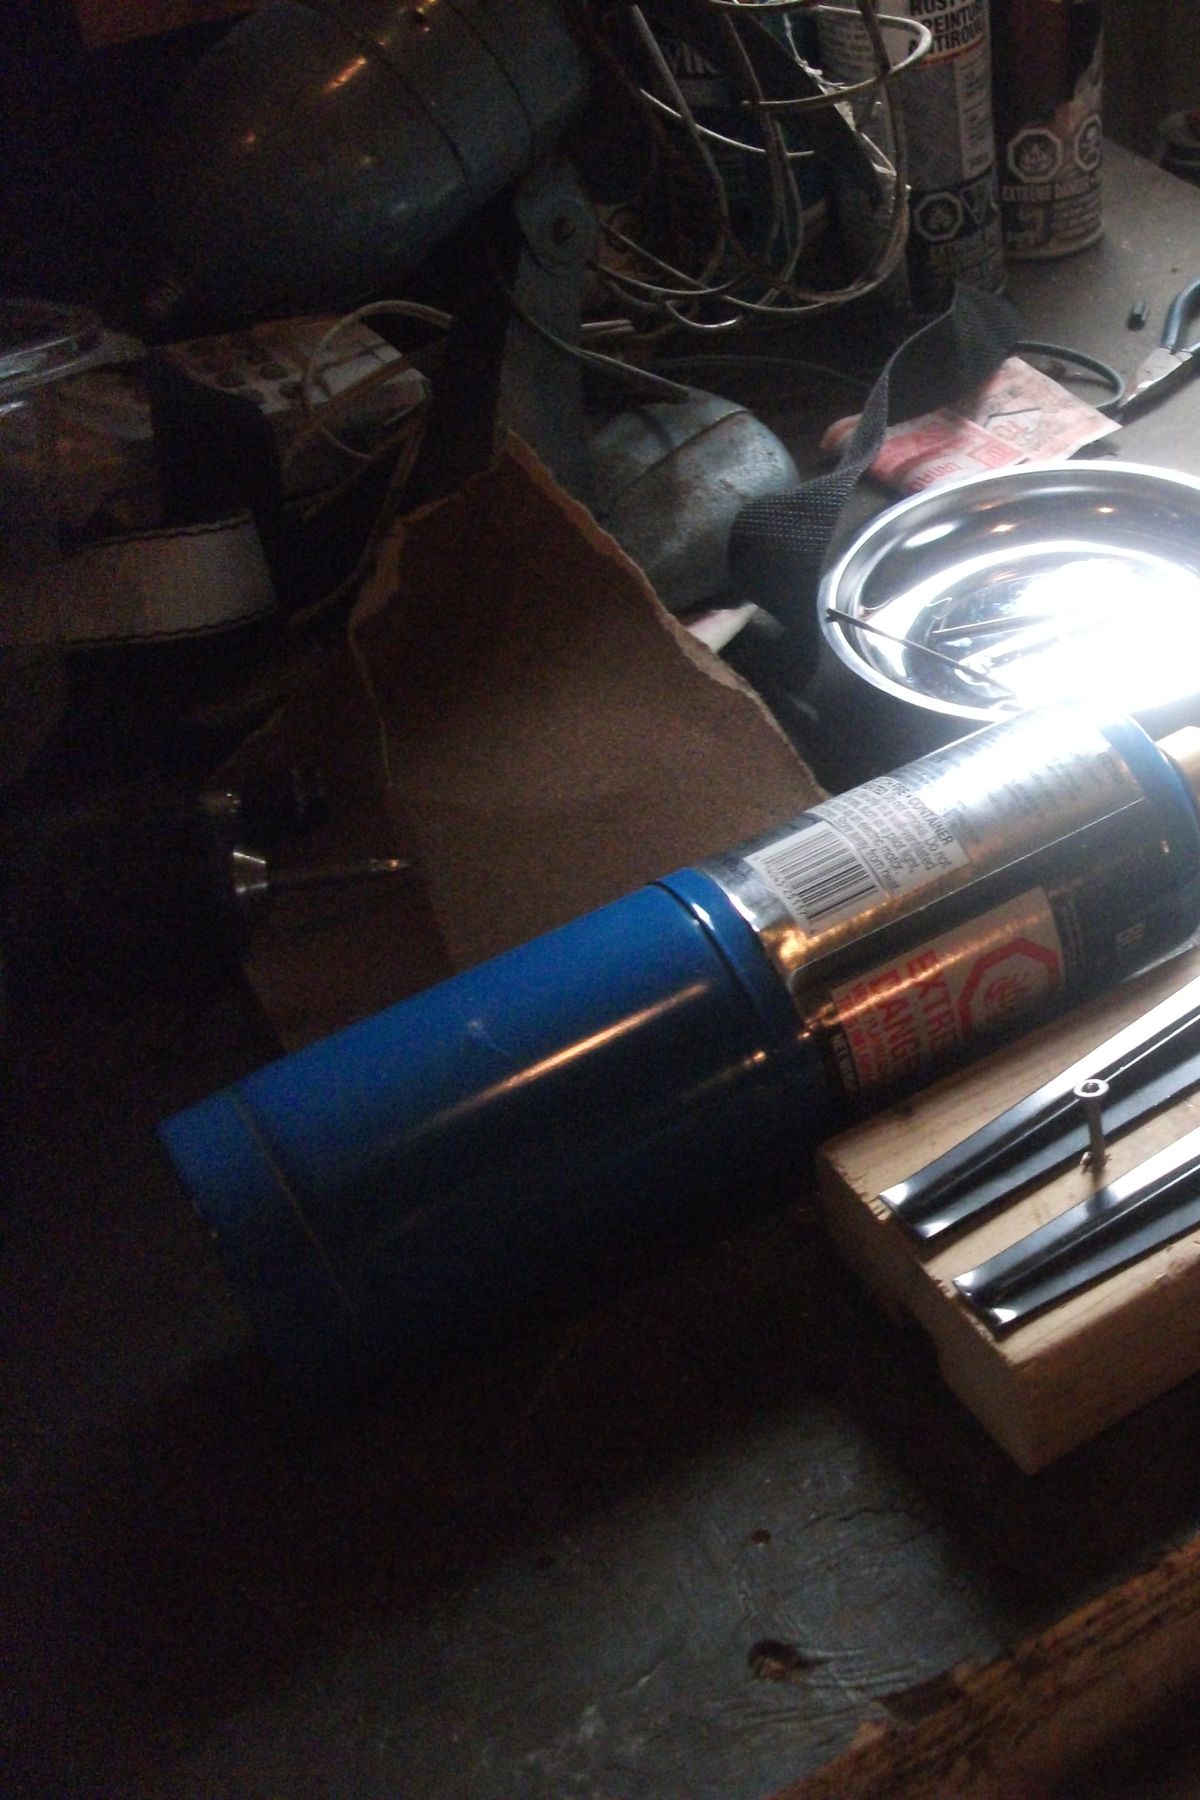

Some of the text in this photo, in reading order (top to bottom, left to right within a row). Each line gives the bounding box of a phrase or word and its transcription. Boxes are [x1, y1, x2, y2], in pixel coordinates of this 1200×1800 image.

[908, 796, 954, 846] CONTAINER
[923, 834, 939, 852] Do
[934, 850, 952, 869] not
